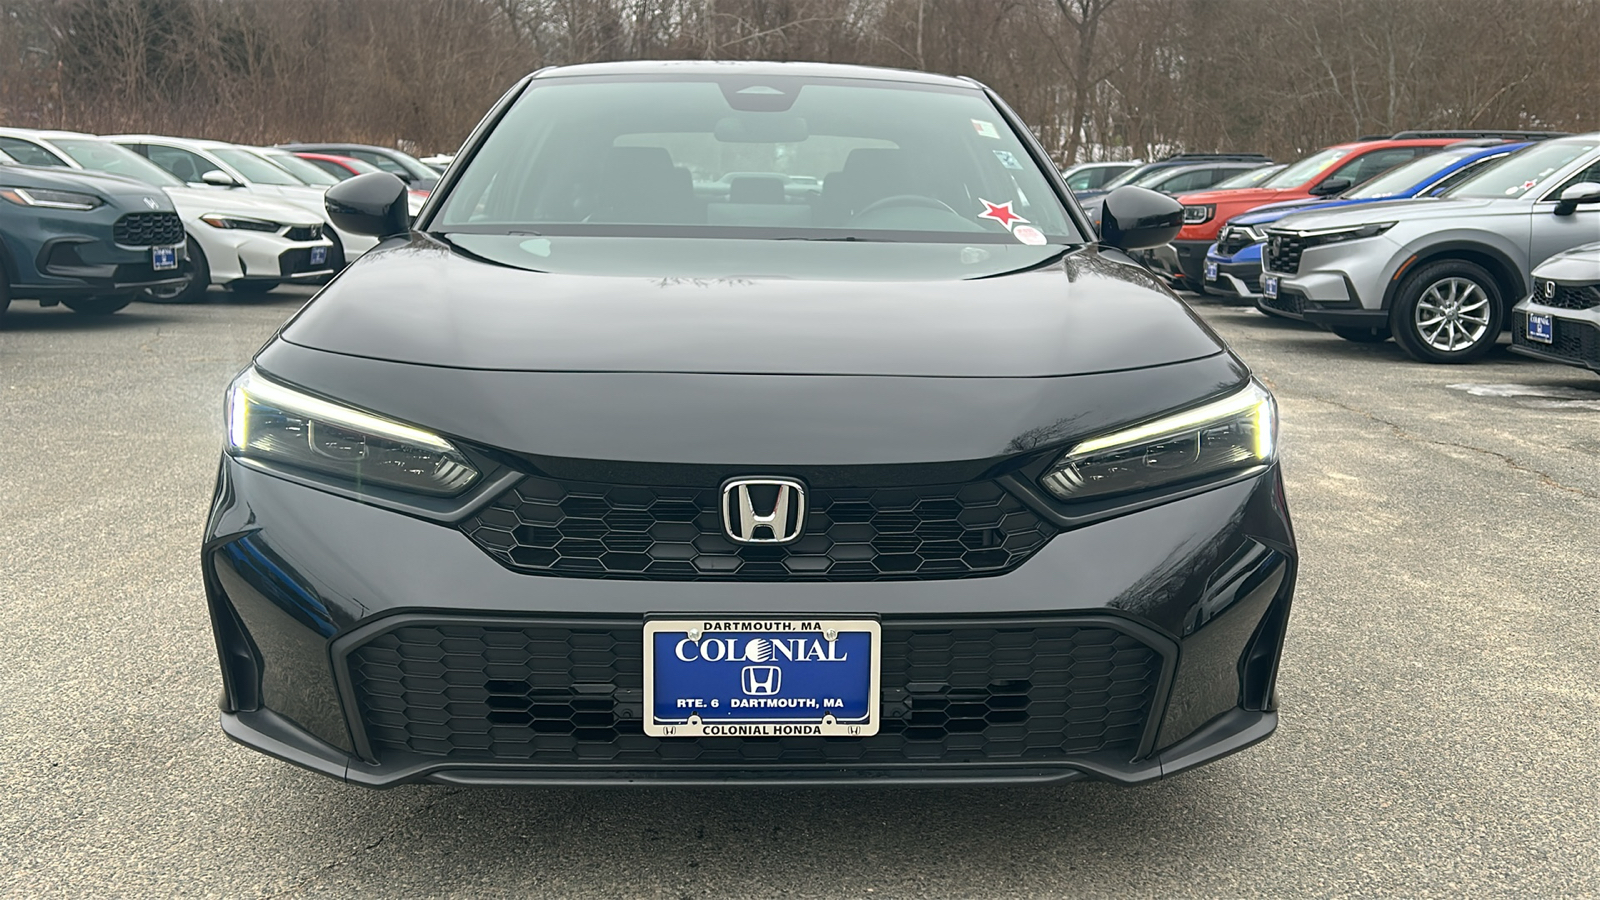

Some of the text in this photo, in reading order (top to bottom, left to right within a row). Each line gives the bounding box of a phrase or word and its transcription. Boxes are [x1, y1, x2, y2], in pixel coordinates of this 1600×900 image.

[703, 622, 822, 631] DARTMOUTH, MA
[675, 638, 848, 662] COLONIAL
[677, 698, 720, 708] RTE. 6
[730, 698, 844, 709] DARTMOUTH, MA
[702, 725, 822, 735] COLONIAL HONDA
